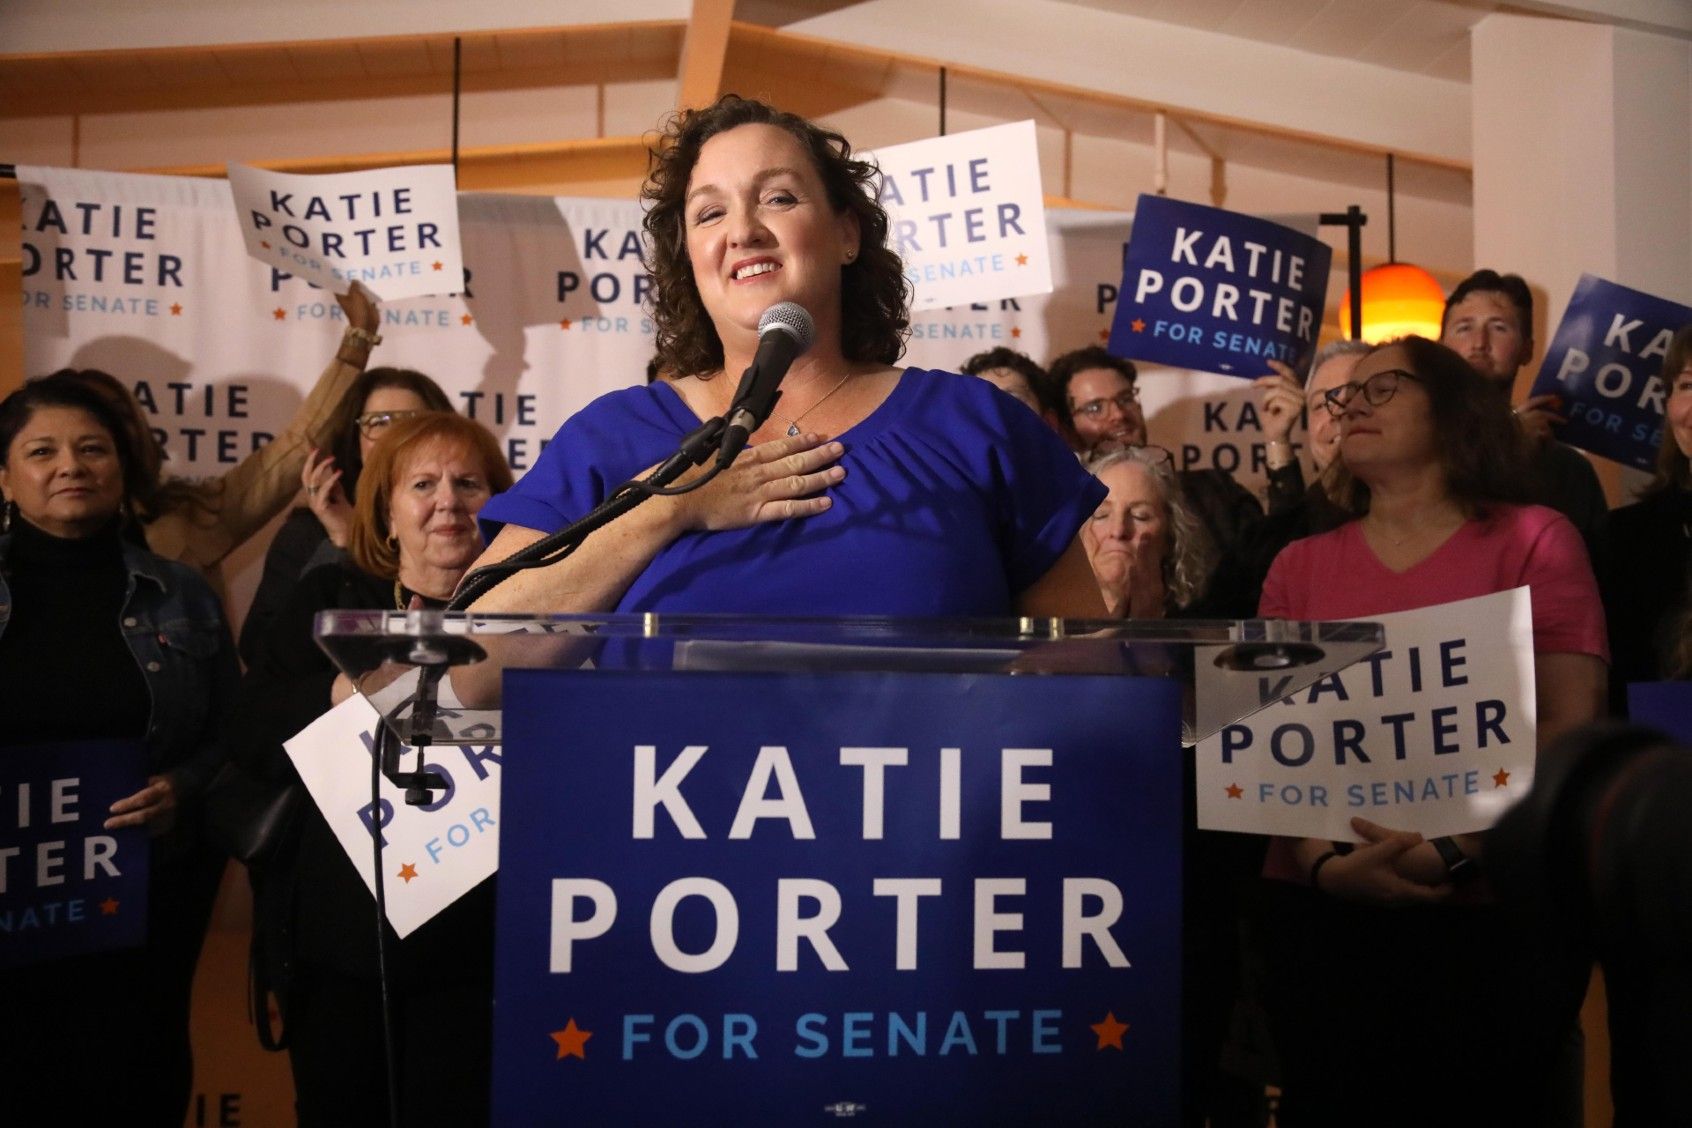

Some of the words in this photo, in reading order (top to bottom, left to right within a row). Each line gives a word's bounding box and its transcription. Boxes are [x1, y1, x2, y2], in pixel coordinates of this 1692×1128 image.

[880, 158, 991, 206] ATIE
[21, 198, 157, 240] ATIE
[270, 188, 412, 221] KATIE
[250, 209, 442, 259] PORTER
[895, 203, 1026, 252] RTER
[21, 242, 184, 288] ORTER
[278, 246, 321, 270] FOR
[331, 260, 421, 282] SENATE
[908, 254, 1005, 285] SENATE
[1171, 227, 1305, 292] KATIE
[22, 291, 50, 309] OR
[62, 295, 159, 316] SENATE
[557, 271, 655, 306] POR
[1134, 268, 1314, 343] PORTER
[297, 303, 342, 321] FOR
[386, 310, 450, 327] NATE
[582, 315, 629, 333] FOR
[913, 323, 1003, 339] SENATE
[1153, 320, 1203, 345] FOR
[133, 380, 249, 418] ATIE
[1555, 347, 1667, 415] POR
[460, 391, 537, 427] TIE
[1568, 401, 1623, 433] FOR
[1258, 638, 1469, 706] KATIE
[1221, 699, 1511, 767] PORTER
[632, 745, 1053, 840] KATIE
[1258, 783, 1329, 808] FOR
[1346, 770, 1480, 808] SENATE
[425, 807, 497, 865] FOR
[0, 835, 122, 894] TER
[0, 899, 86, 933] NATE
[549, 876, 1132, 974] PORTER
[622, 1013, 759, 1061] FOR
[794, 1009, 1064, 1058] SENATE
